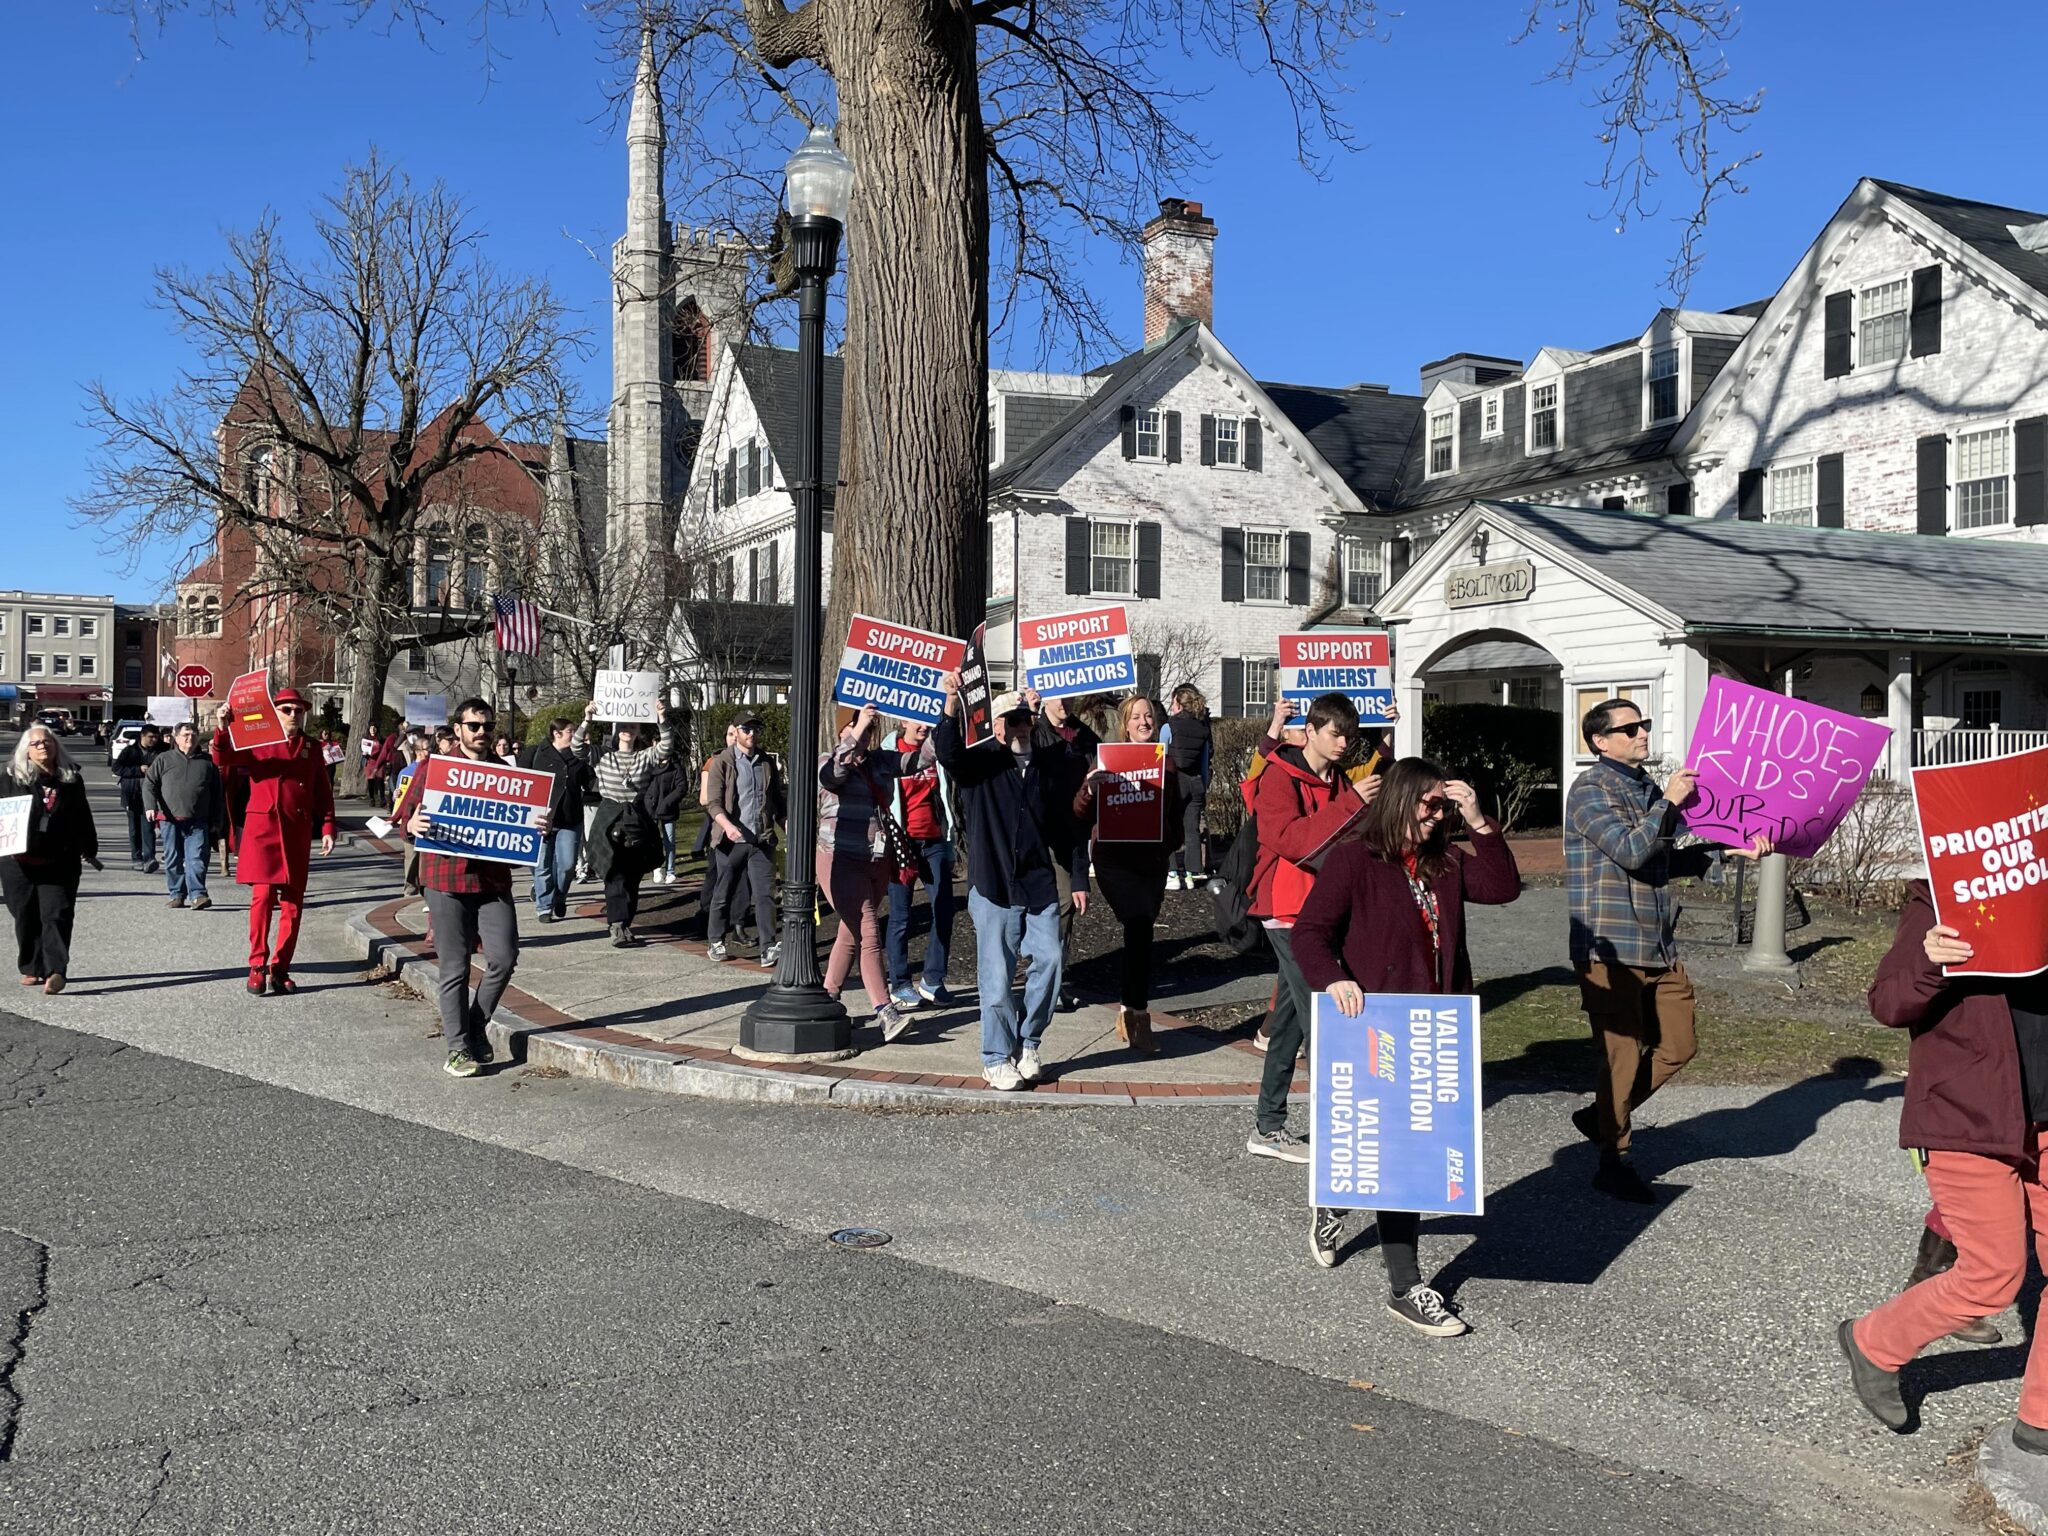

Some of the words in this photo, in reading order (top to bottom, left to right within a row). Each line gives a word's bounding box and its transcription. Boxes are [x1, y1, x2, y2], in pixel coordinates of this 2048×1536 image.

[1456, 569, 1528, 600] BOLTWOOD
[1036, 615, 1110, 642] SUPPORT
[866, 628, 948, 663] SUPPORT
[1038, 638, 1116, 666] AMHERST
[1296, 641, 1373, 661] SUPPORT
[179, 675, 211, 688] STOP
[599, 672, 633, 685] FULLY
[856, 653, 943, 689] AMHERST
[1033, 661, 1128, 691] EDUCATORS
[1296, 668, 1377, 688] AMHERST
[597, 686, 634, 699] FUND
[841, 677, 943, 716] EDUCATORS
[596, 700, 650, 717] SCHOOLS
[1713, 688, 1860, 774] WHOSE
[446, 768, 534, 798] SUPPORT
[1106, 768, 1160, 784] RIORITIZE
[1120, 781, 1141, 792] OUR
[438, 794, 532, 825] AMHERST
[1107, 790, 1155, 806] SCHOOLS
[1686, 785, 1783, 823] OUR
[424, 822, 534, 853] EDUCATORS
[1982, 839, 2035, 872] OUR
[1377, 1029, 1396, 1082] MEANS
[1410, 1008, 1433, 1132] EDUCATION
[1436, 1008, 1460, 1103] VALUING
[1331, 1062, 1353, 1193] EDUCATORS
[1357, 1098, 1380, 1194] VALUING
[1449, 1147, 1464, 1183] APEA
